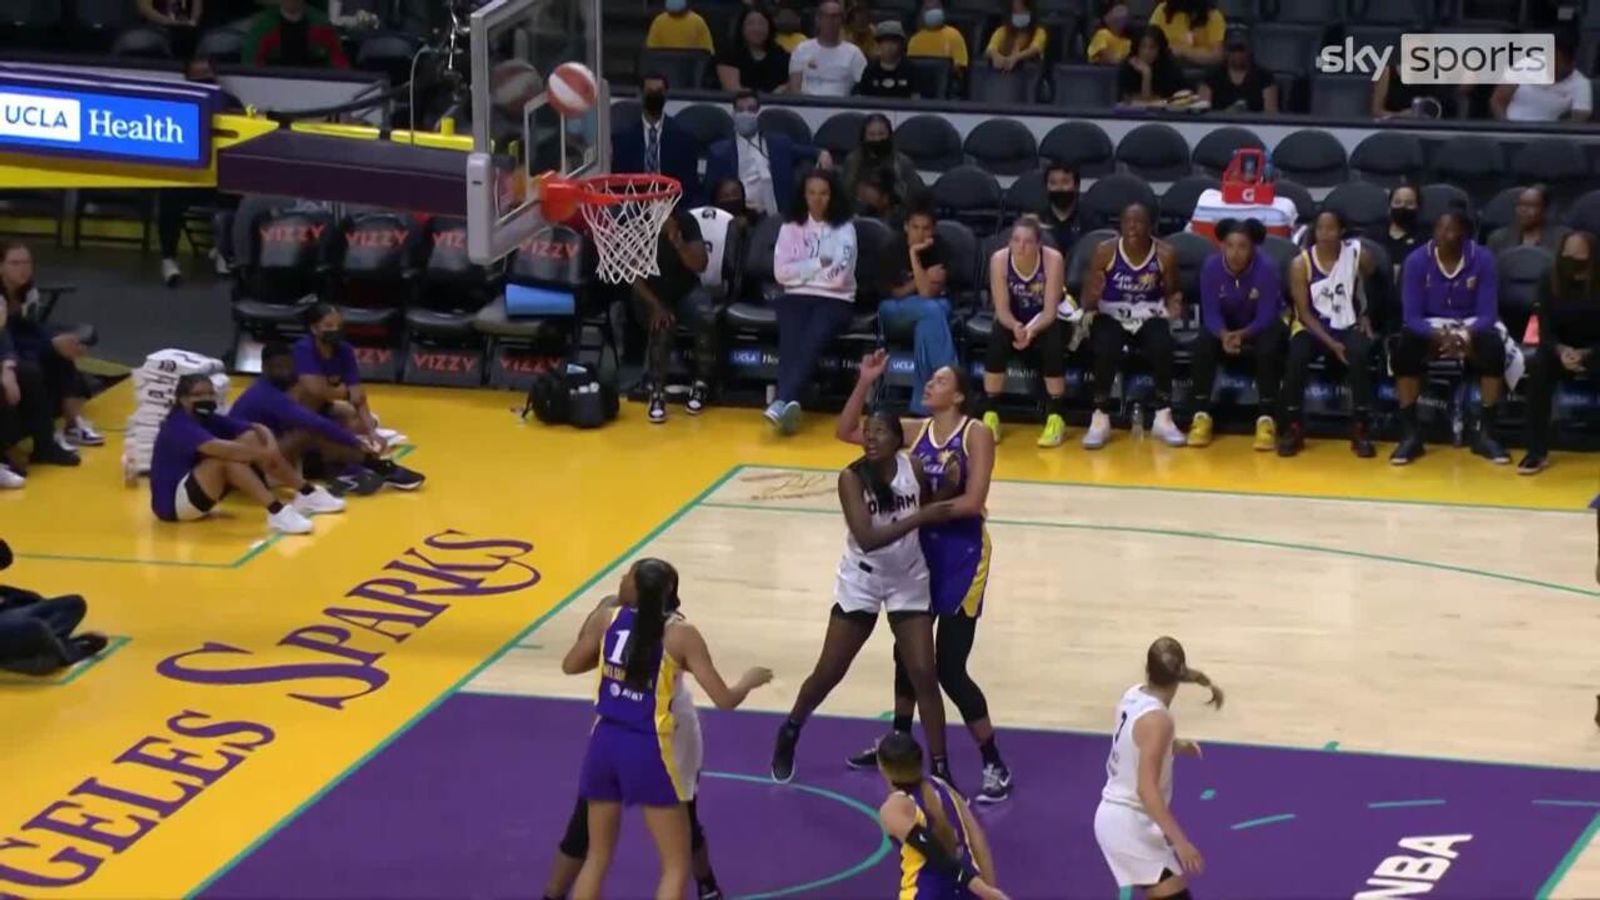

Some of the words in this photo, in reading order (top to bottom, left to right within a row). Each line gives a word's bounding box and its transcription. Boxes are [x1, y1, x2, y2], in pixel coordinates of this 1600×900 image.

[5, 104, 68, 129] UCLA
[87, 108, 184, 143] Health
[260, 224, 325, 242] VIZZY
[345, 229, 409, 248] VIZZY
[432, 228, 467, 249] VIZ
[353, 347, 391, 364] ZZY
[412, 352, 476, 373] VIZZY
[0, 709, 276, 900] GELES
[155, 528, 542, 711] SPARKS
[1353, 834, 1474, 900] NBA
